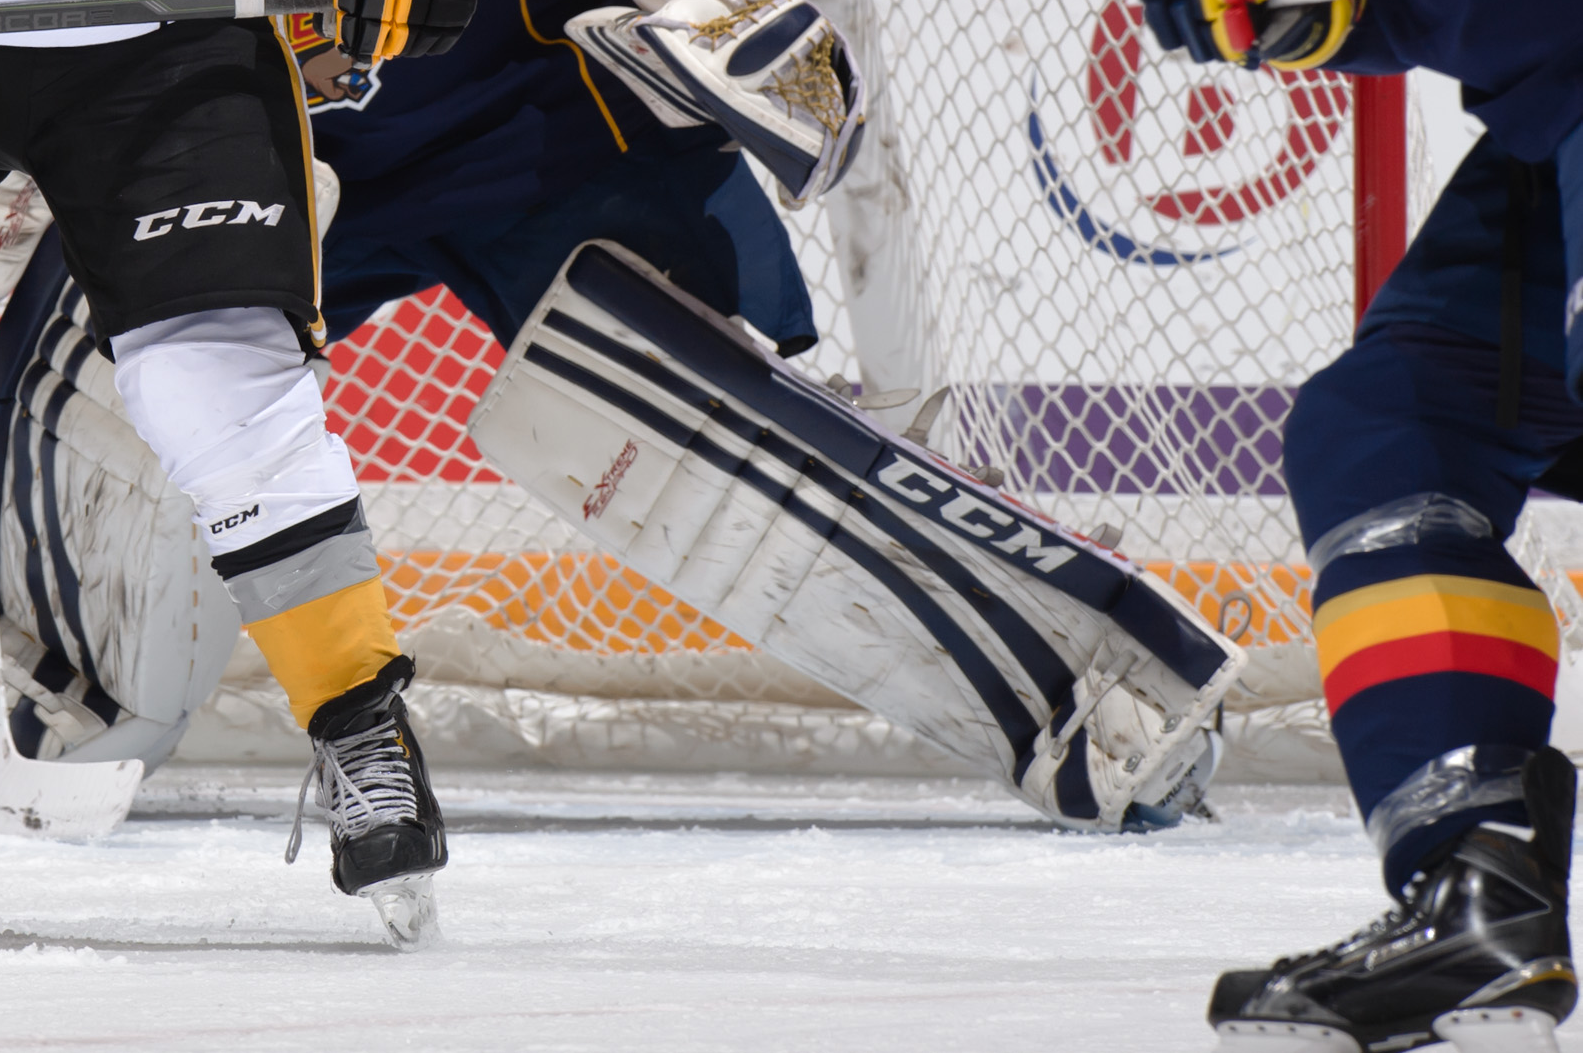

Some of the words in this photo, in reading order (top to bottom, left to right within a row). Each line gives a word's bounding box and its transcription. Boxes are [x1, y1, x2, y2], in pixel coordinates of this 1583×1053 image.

[133, 199, 285, 242] CCM
[210, 503, 261, 535] CCM
[873, 452, 1079, 574] CCM
